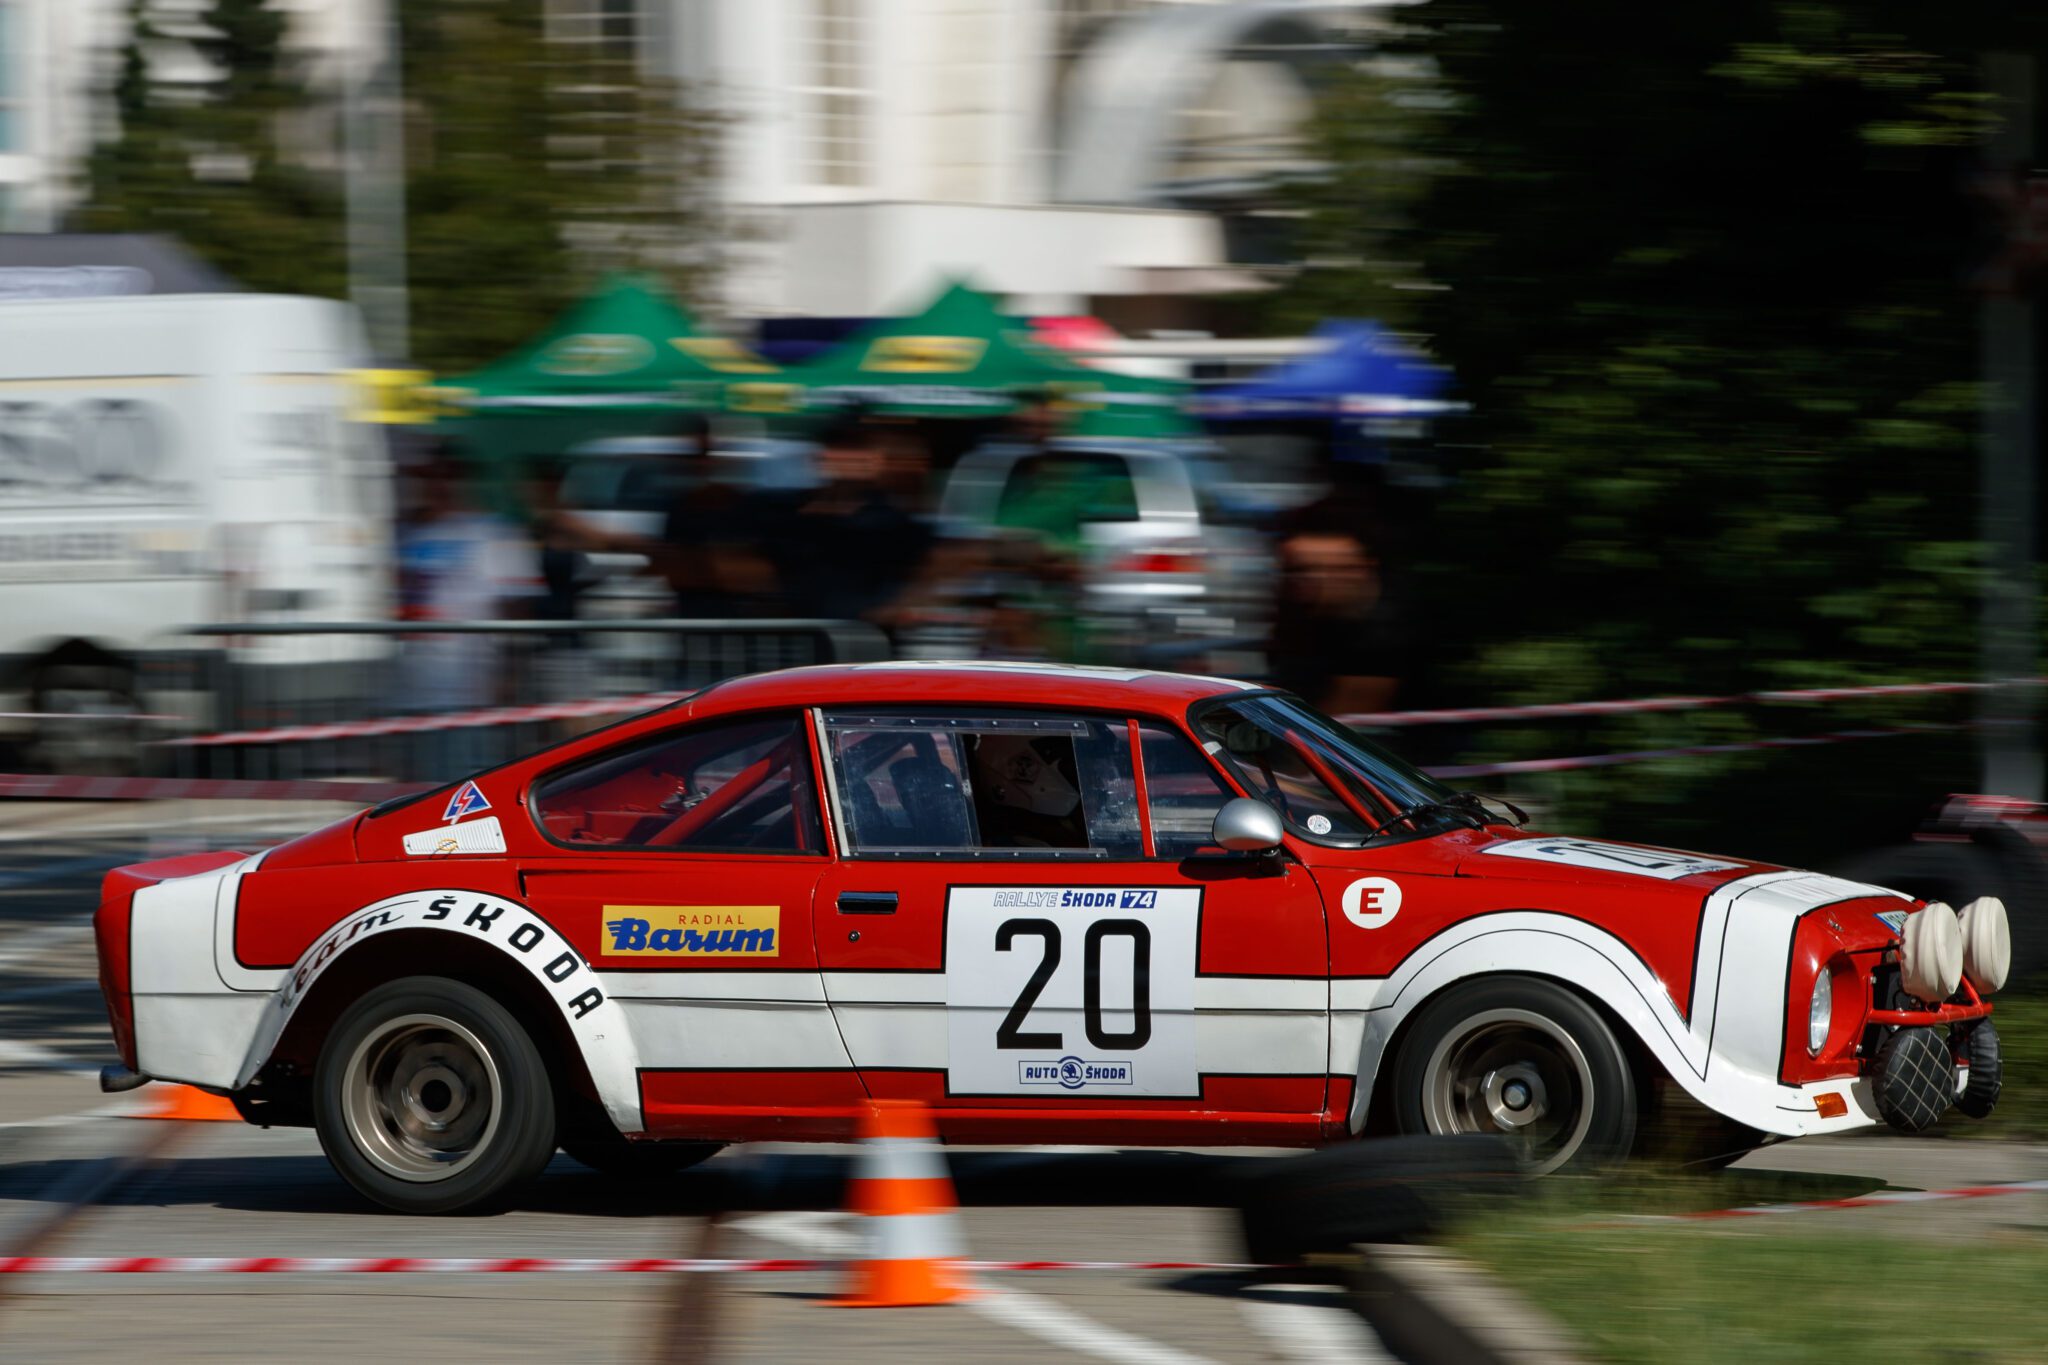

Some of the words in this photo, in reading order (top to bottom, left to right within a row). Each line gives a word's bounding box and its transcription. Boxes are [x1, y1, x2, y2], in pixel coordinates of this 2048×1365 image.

[1536, 841, 1703, 869] 20
[993, 891, 1058, 908] RALLYE
[1060, 890, 1117, 907] ŠKODA
[1123, 891, 1153, 908] '74
[1359, 887, 1385, 915] E
[678, 914, 745, 925] RADIAL
[606, 917, 775, 953] Barum
[422, 895, 604, 1020] ŠKODA
[995, 918, 1152, 1050] 20
[1025, 1067, 1059, 1079] AUTO
[1085, 1065, 1126, 1080] ŠKODA
